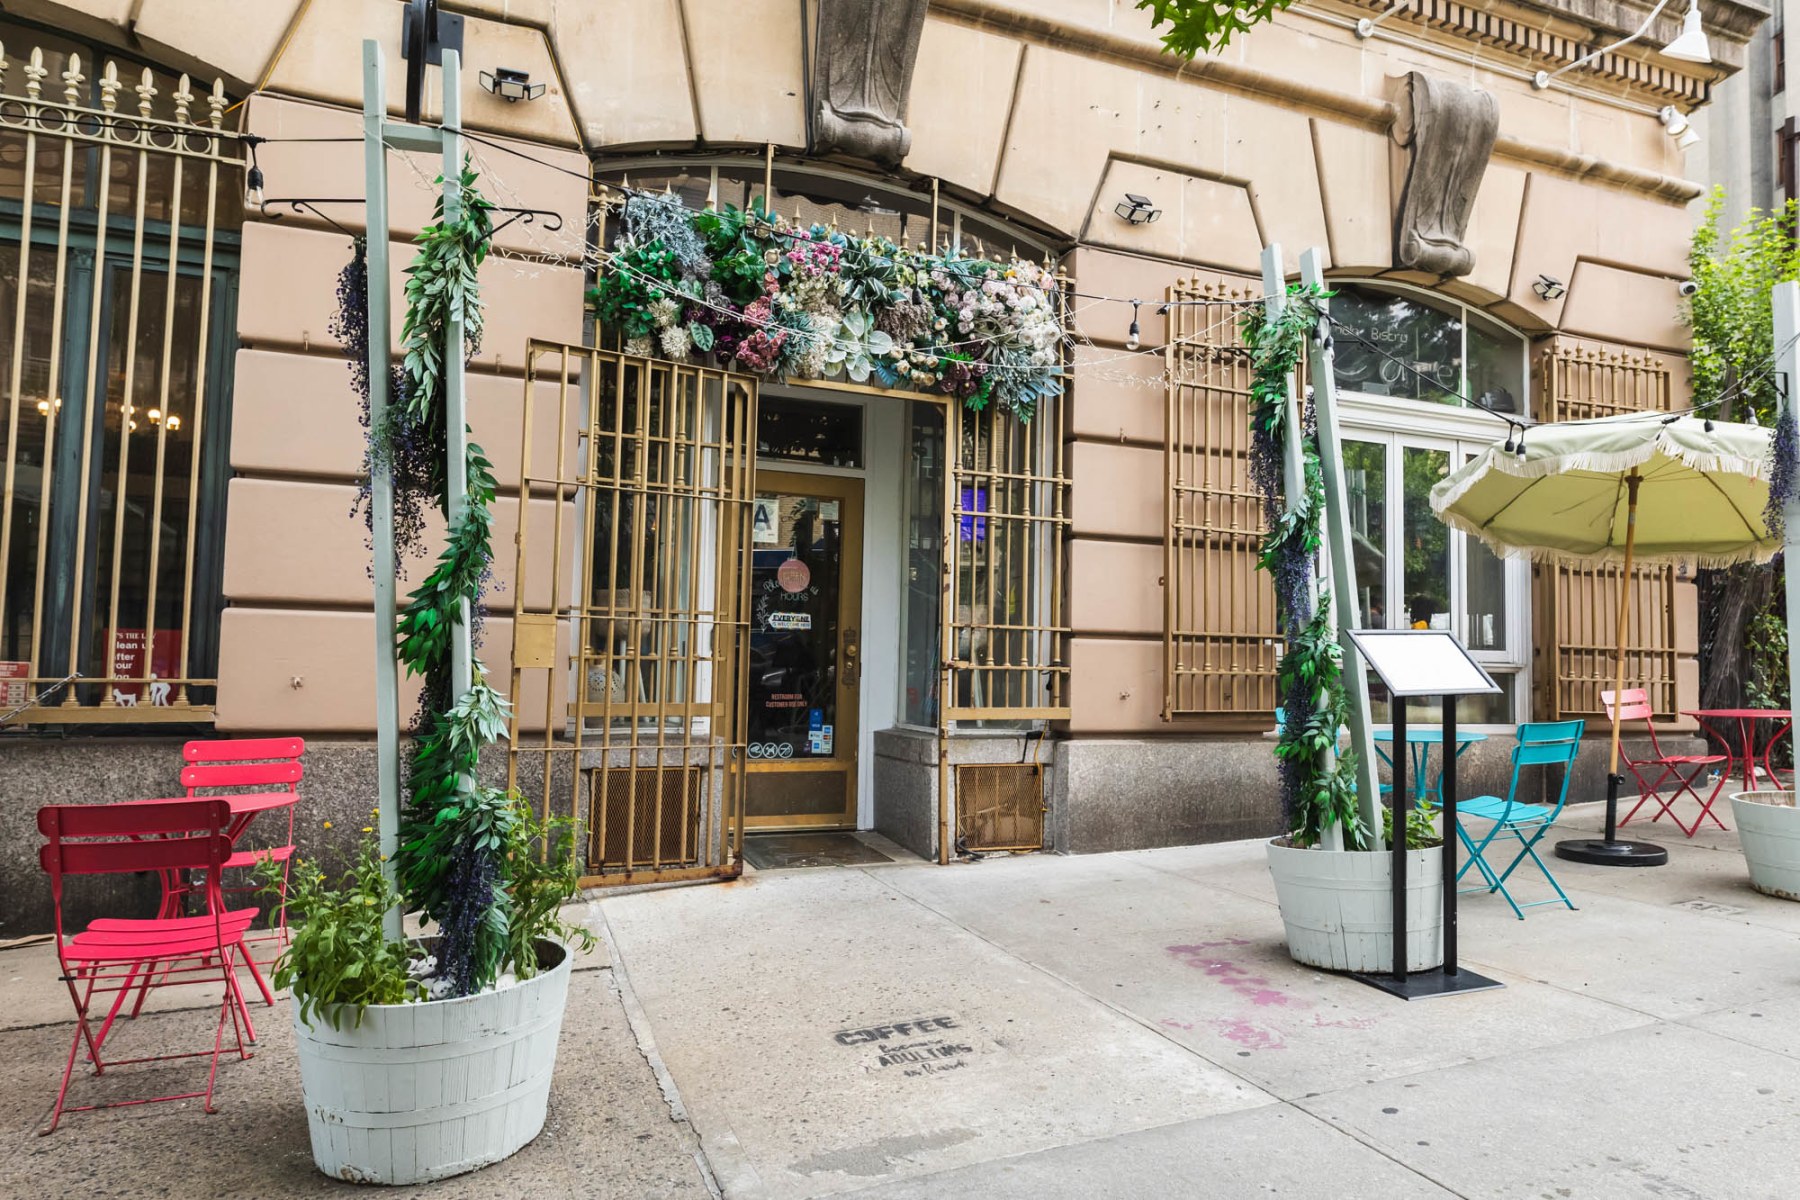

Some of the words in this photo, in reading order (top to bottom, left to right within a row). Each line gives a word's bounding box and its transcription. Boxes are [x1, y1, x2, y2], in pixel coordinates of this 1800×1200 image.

[1370, 325, 1408, 343] Bistro
[754, 503, 773, 530] A
[780, 591, 809, 602] HOURS
[116, 641, 138, 649] lean
[115, 653, 135, 661] fter
[834, 1016, 959, 1045] COFFEE
[878, 1043, 973, 1067] ADULTING
